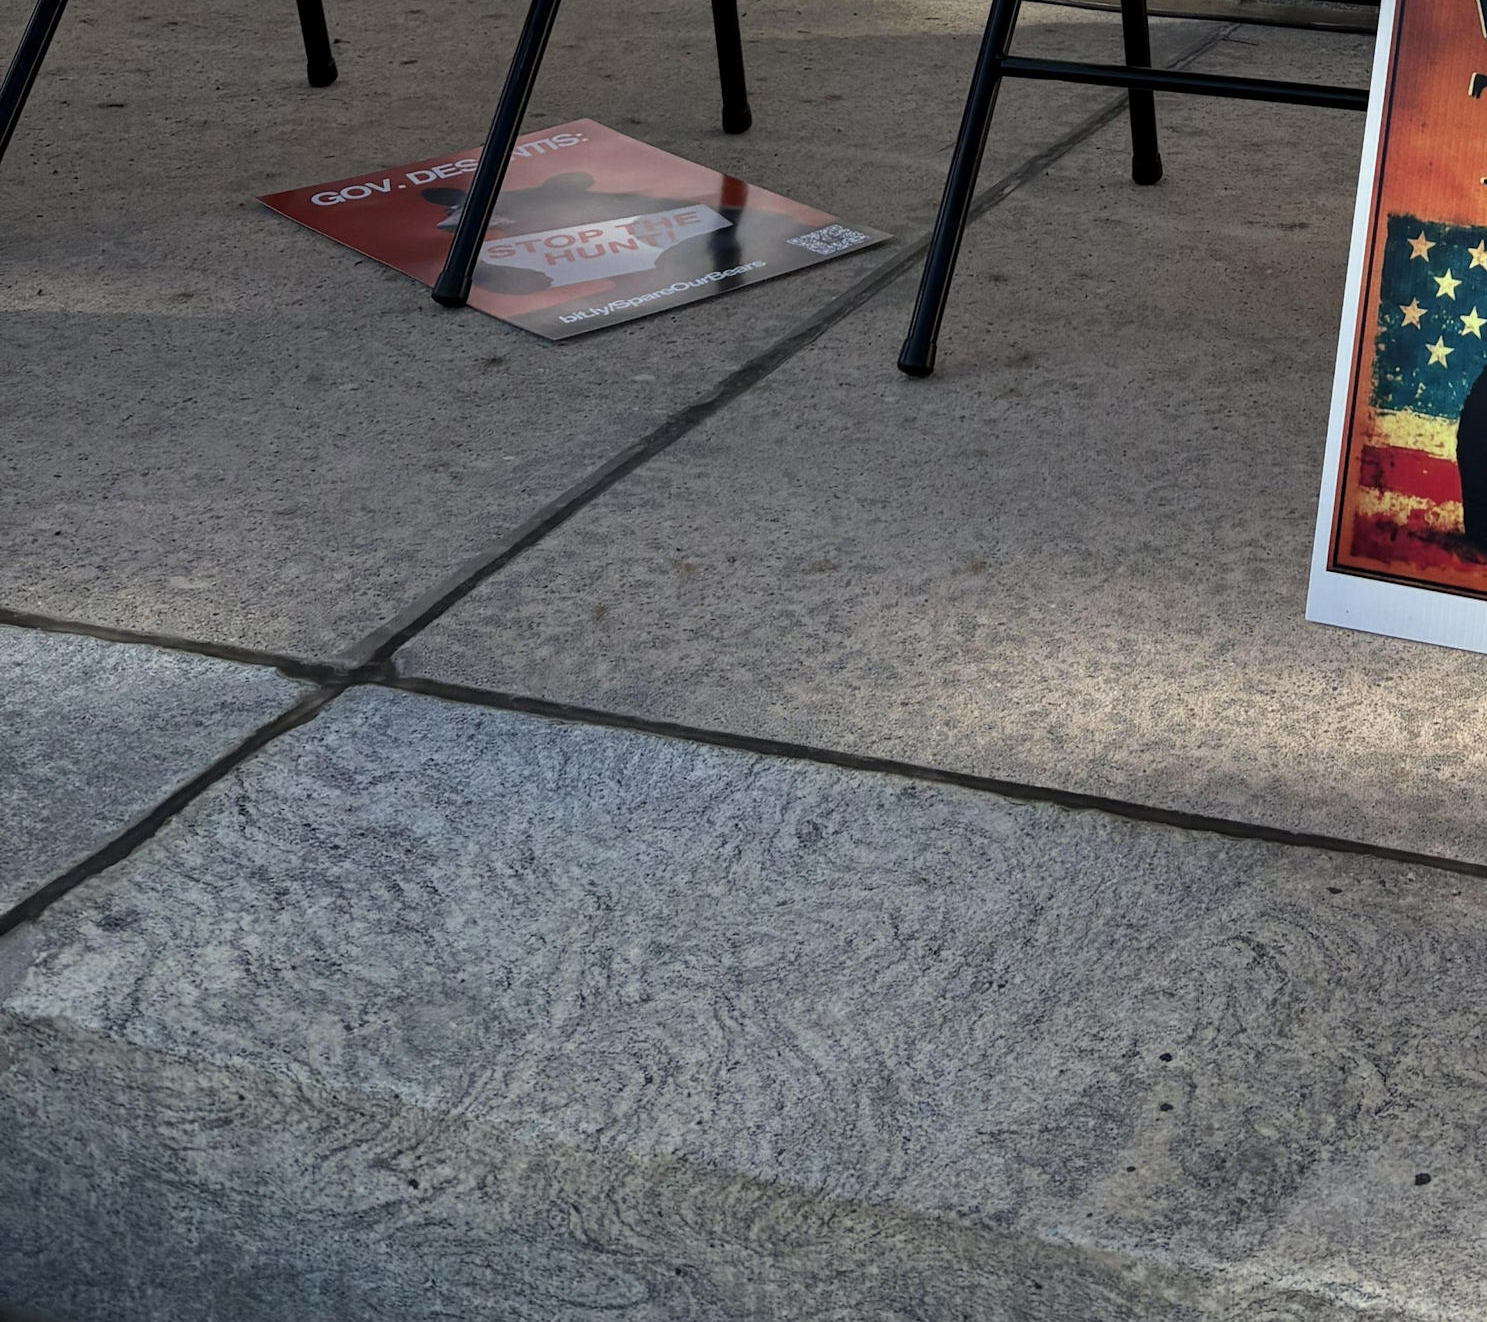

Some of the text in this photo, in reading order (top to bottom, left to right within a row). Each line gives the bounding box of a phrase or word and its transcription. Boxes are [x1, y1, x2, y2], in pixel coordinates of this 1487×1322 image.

[311, 132, 590, 206] GOV. DESNTIS:
[487, 210, 701, 259] STOP THE
[544, 230, 677, 266] HUNT!
[559, 258, 767, 324] bit.ly/SpareOurBears
